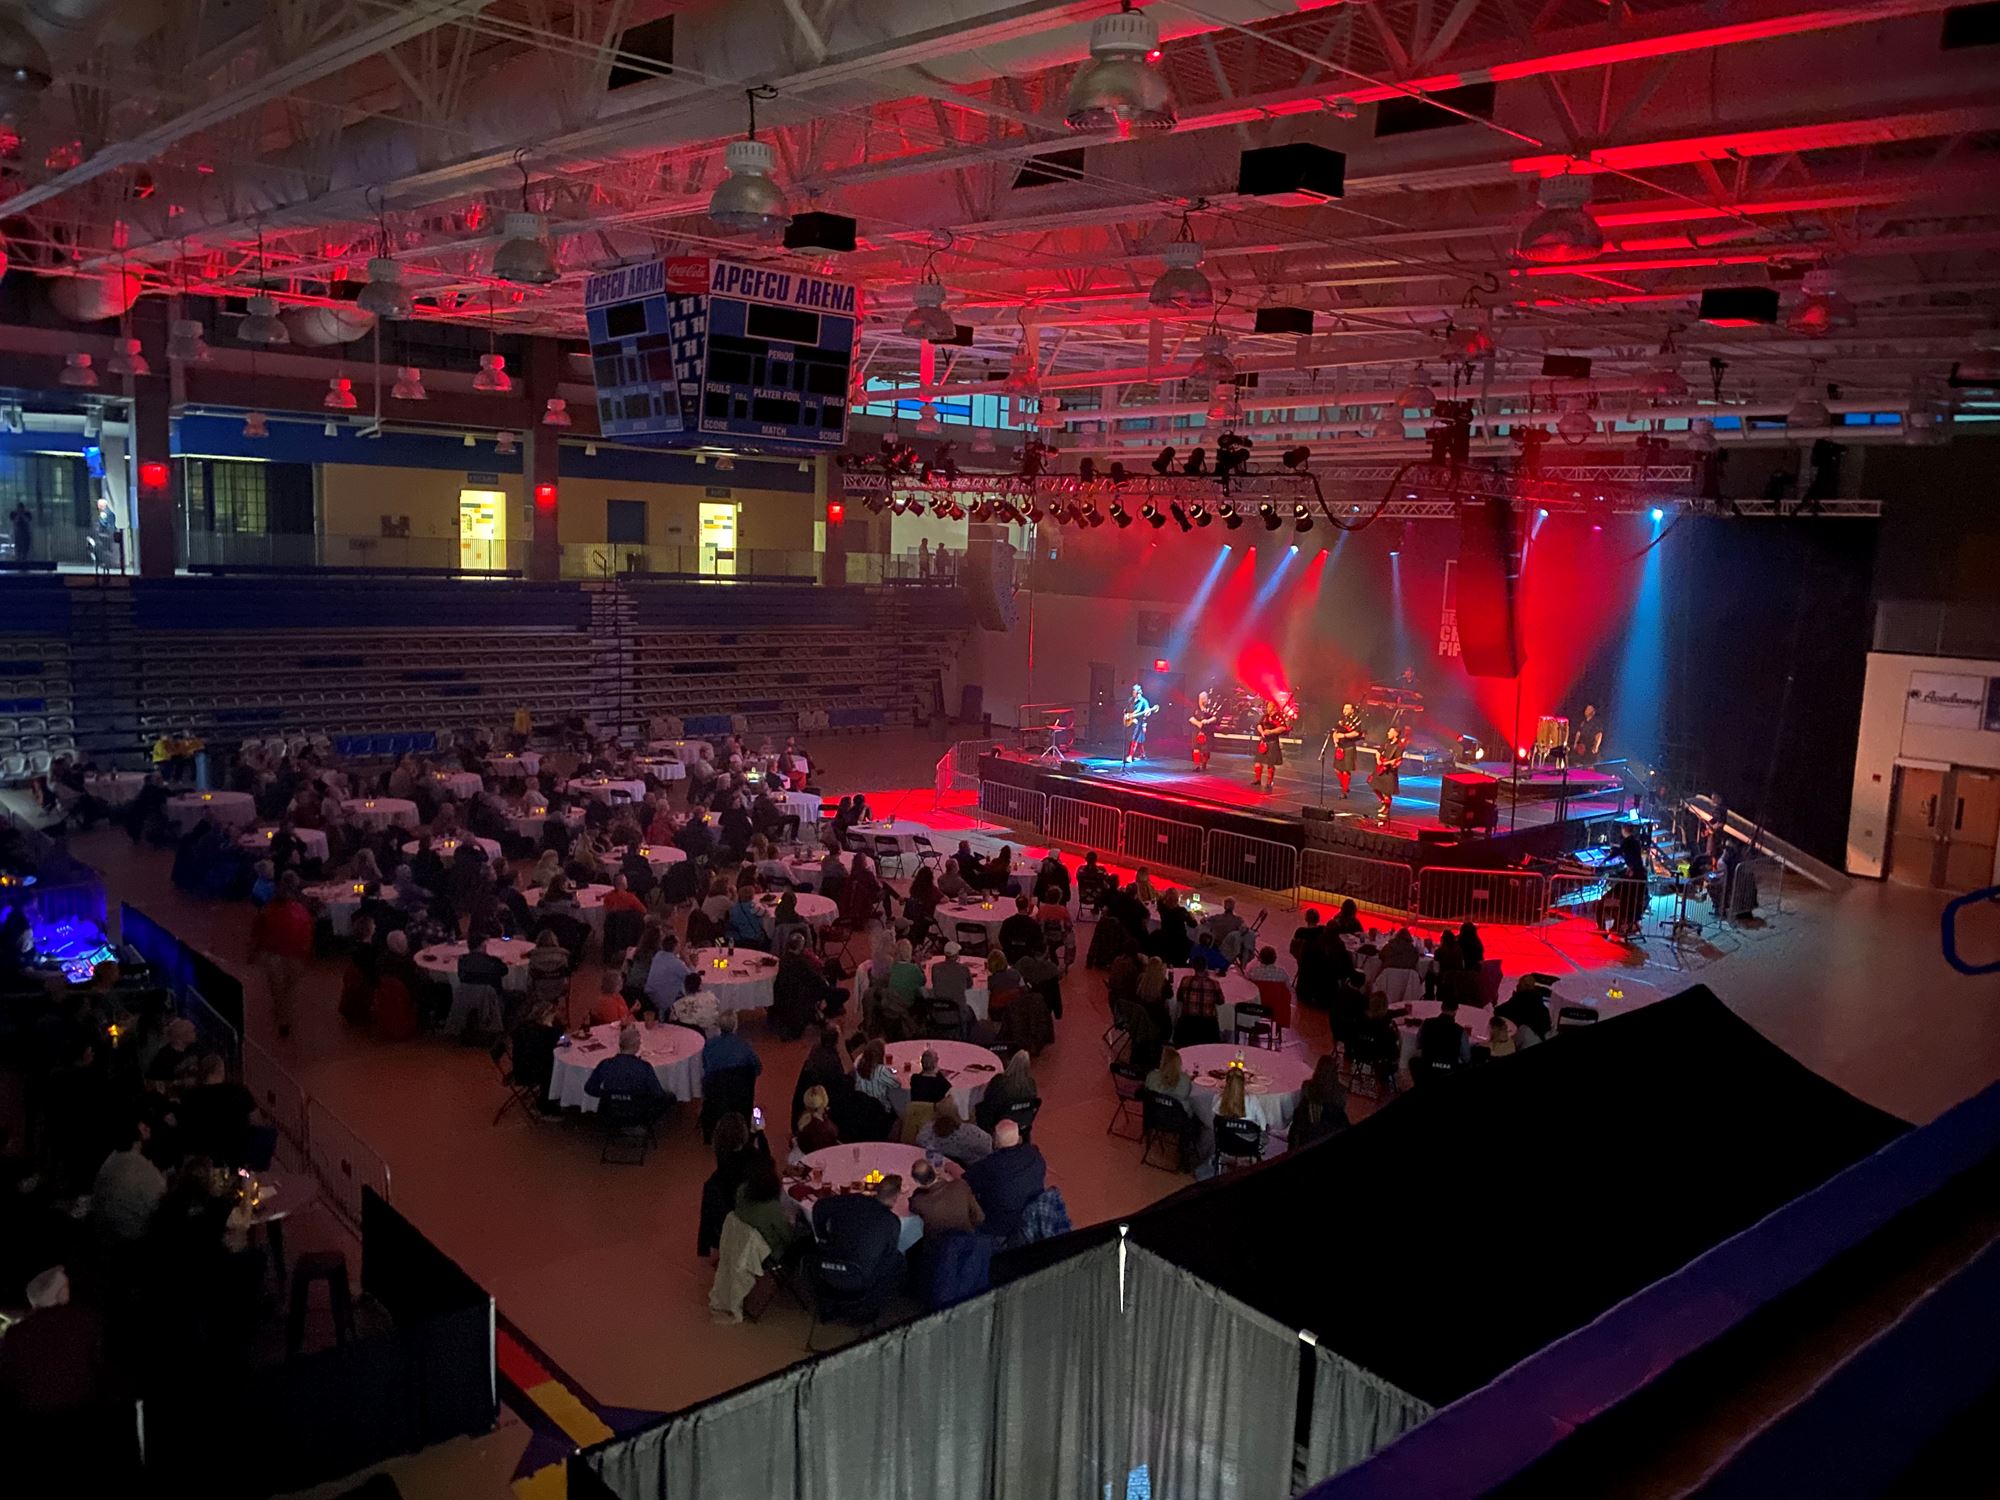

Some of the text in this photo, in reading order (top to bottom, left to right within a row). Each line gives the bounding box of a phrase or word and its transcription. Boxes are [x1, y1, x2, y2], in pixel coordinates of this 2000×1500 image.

[586, 261, 664, 305] APGFCU ARENA
[711, 263, 855, 312] APGFCU ARENA
[768, 350, 795, 361] PERIOD
[706, 382, 731, 394] FOULS
[753, 388, 801, 403] PLAYER FOUL
[823, 396, 845, 407] FOULS
[703, 419, 729, 431] SCORE
[761, 425, 787, 436] MATCH
[818, 431, 841, 442] SCORE
[1439, 642, 1461, 656] PIP
